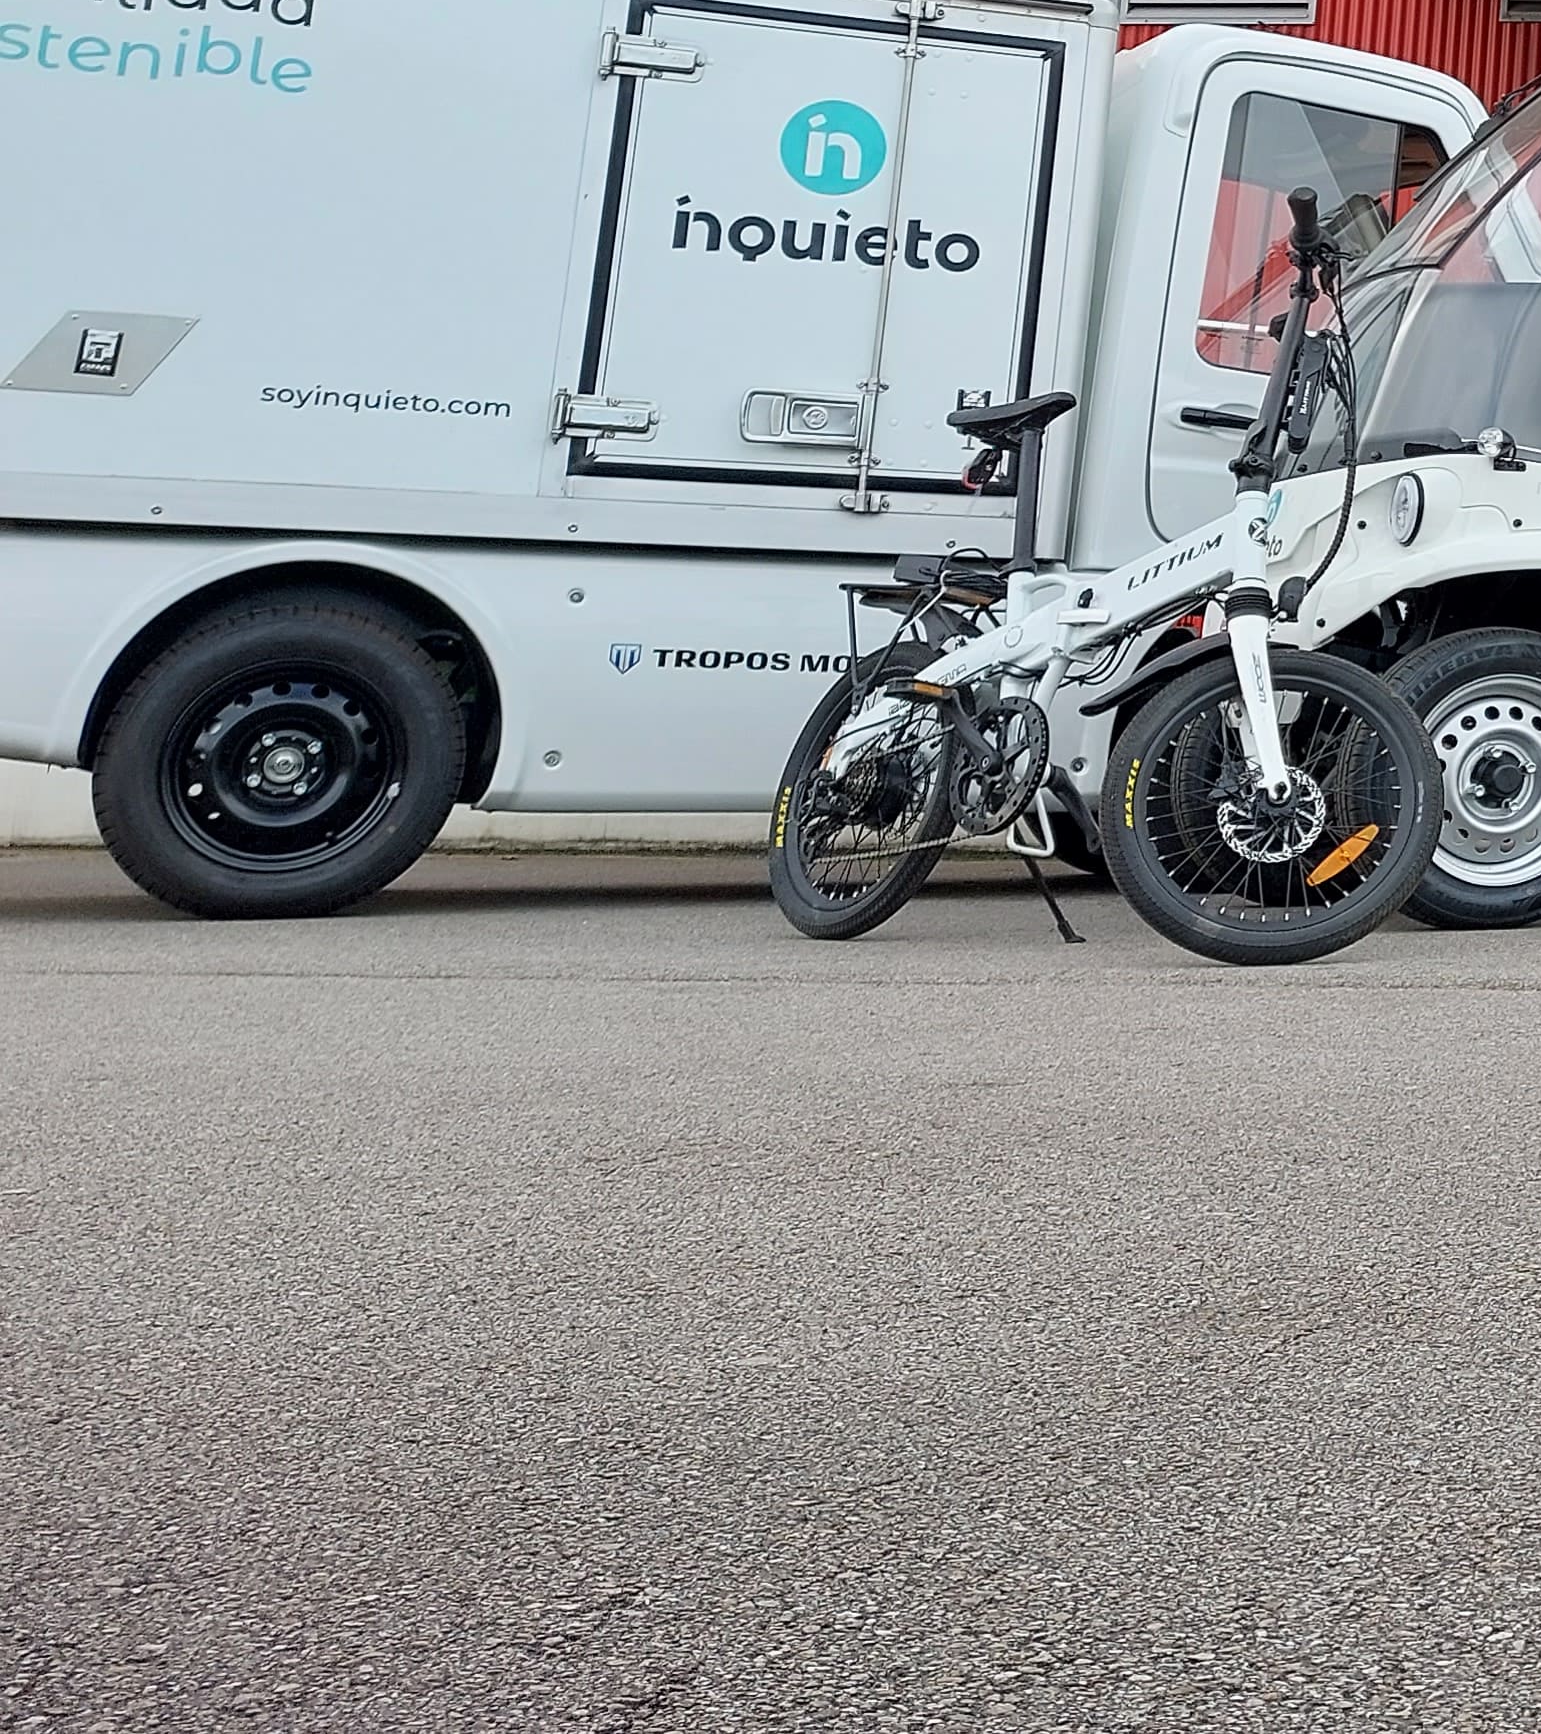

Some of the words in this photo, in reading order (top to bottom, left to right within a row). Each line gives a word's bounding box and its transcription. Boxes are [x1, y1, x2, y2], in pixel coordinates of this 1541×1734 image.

[0, 23, 313, 94] stenible
[671, 194, 981, 273] inquieto
[260, 384, 512, 418] soyinquieto.com
[1127, 531, 1225, 591] LITTIUM
[653, 649, 791, 672] TROPOS
[775, 786, 792, 848] MAXXIS
[1126, 758, 1140, 829] MAXXIS
